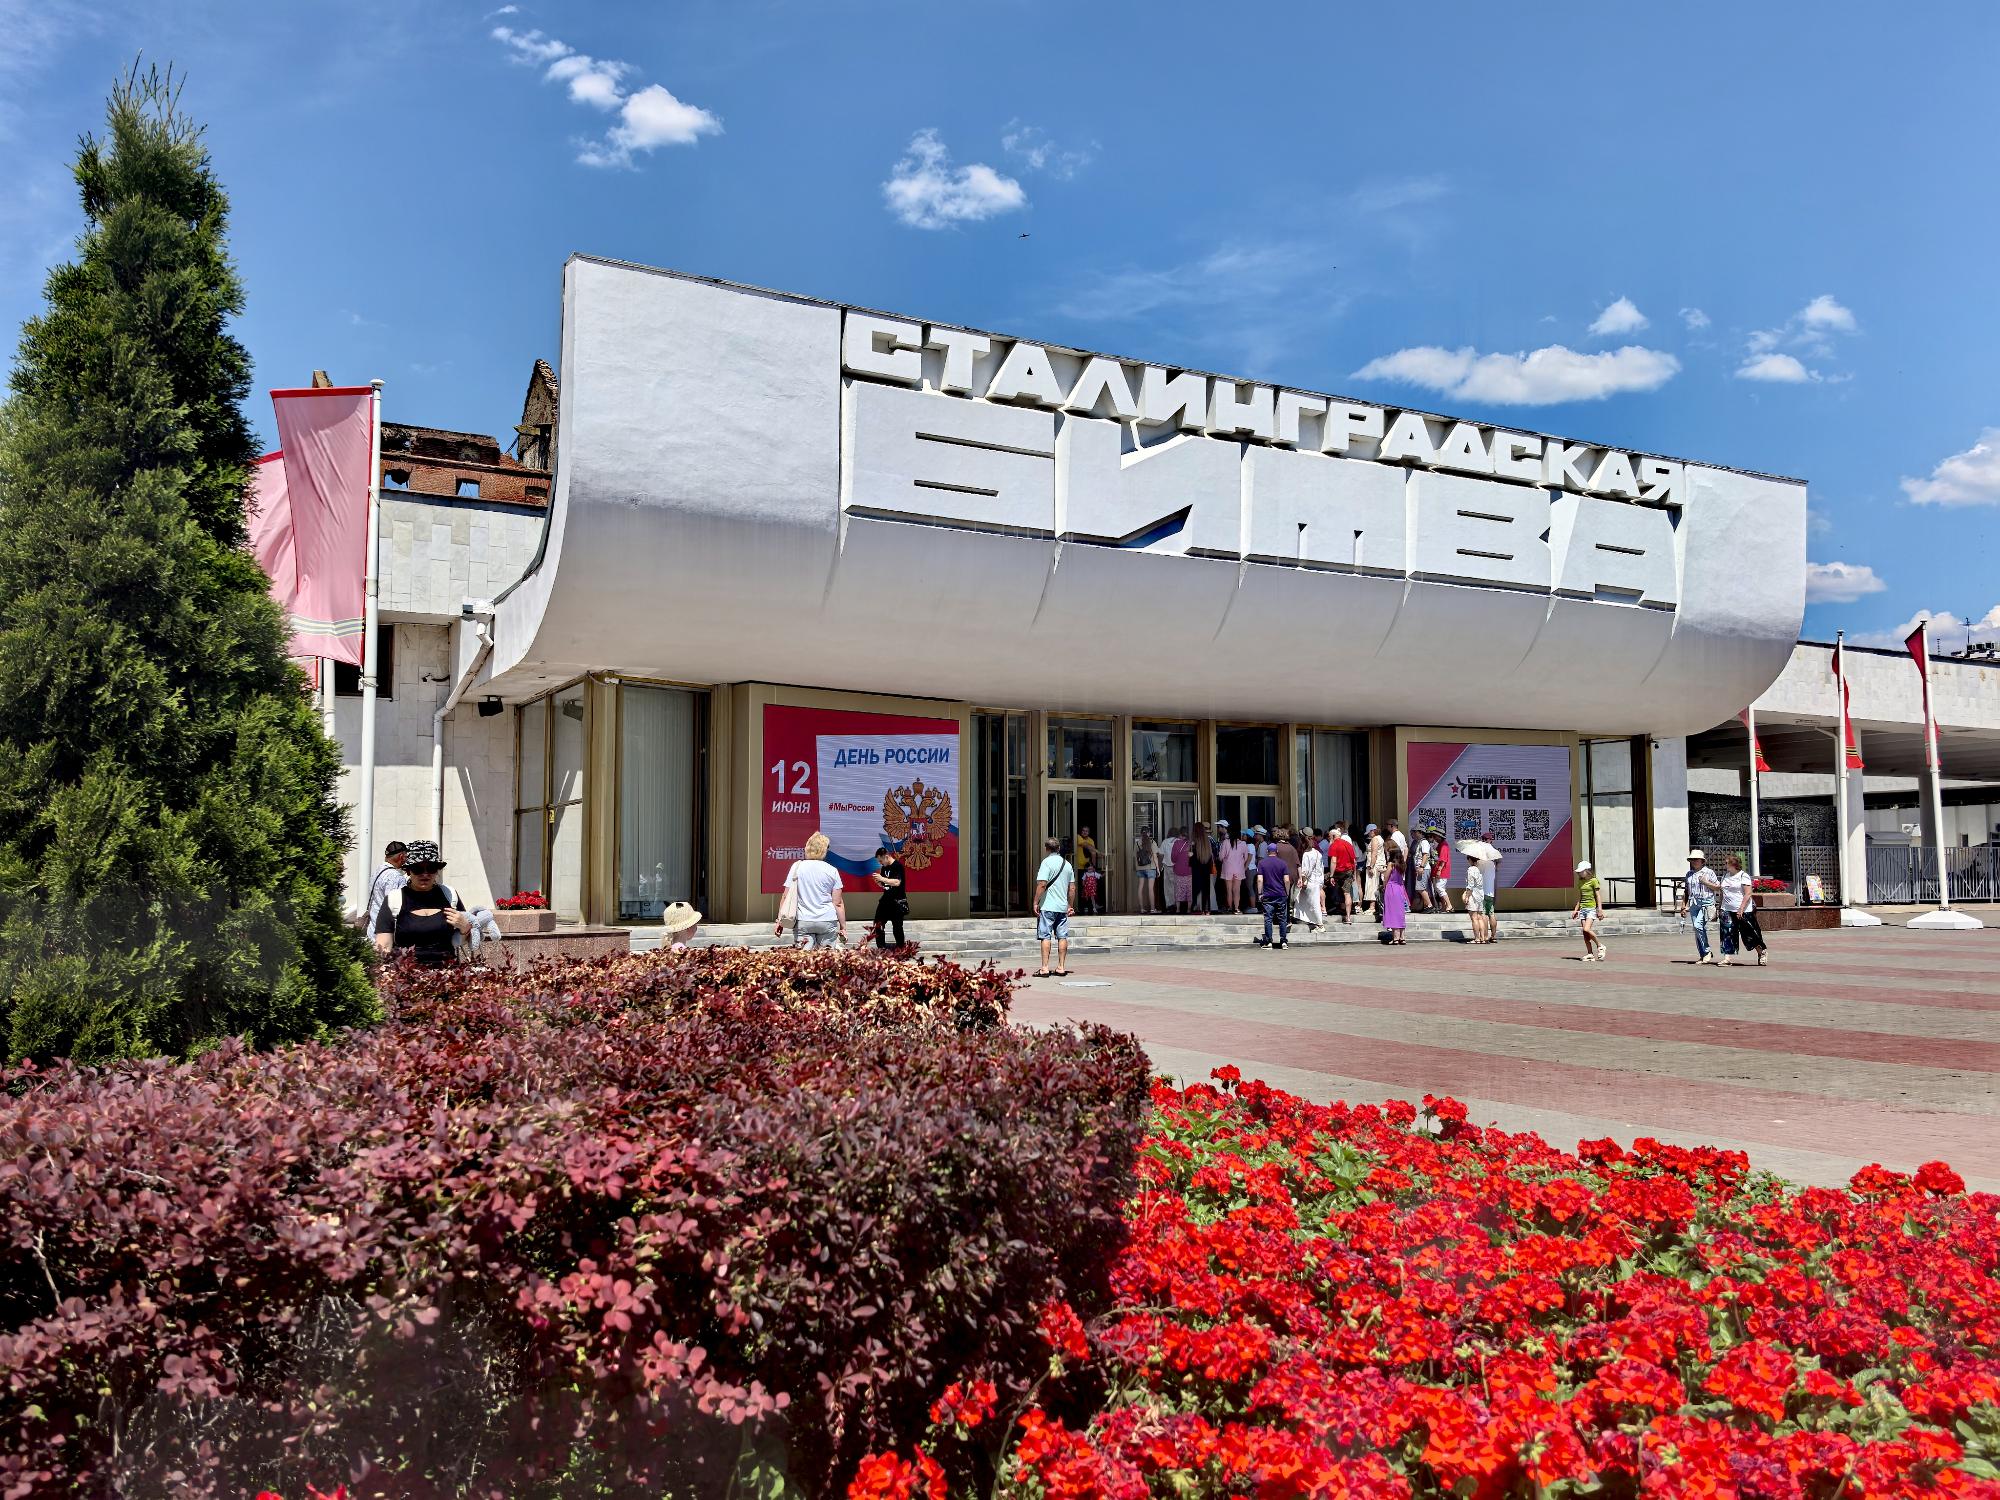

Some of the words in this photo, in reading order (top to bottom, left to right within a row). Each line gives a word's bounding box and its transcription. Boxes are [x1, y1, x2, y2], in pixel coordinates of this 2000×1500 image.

[842, 312, 1684, 506] СТАЛИНГРАДСКАЯ
[847, 380, 1680, 605] БИТВА
[834, 748, 880, 768] ДЕНЬ
[884, 747, 950, 765] РОССИИ
[771, 759, 811, 795] 12
[1468, 785, 1536, 800] БИТВА
[771, 800, 811, 814] ИЮНЯ
[828, 802, 875, 812] #МыРоссия
[775, 850, 806, 860] БИТВ
